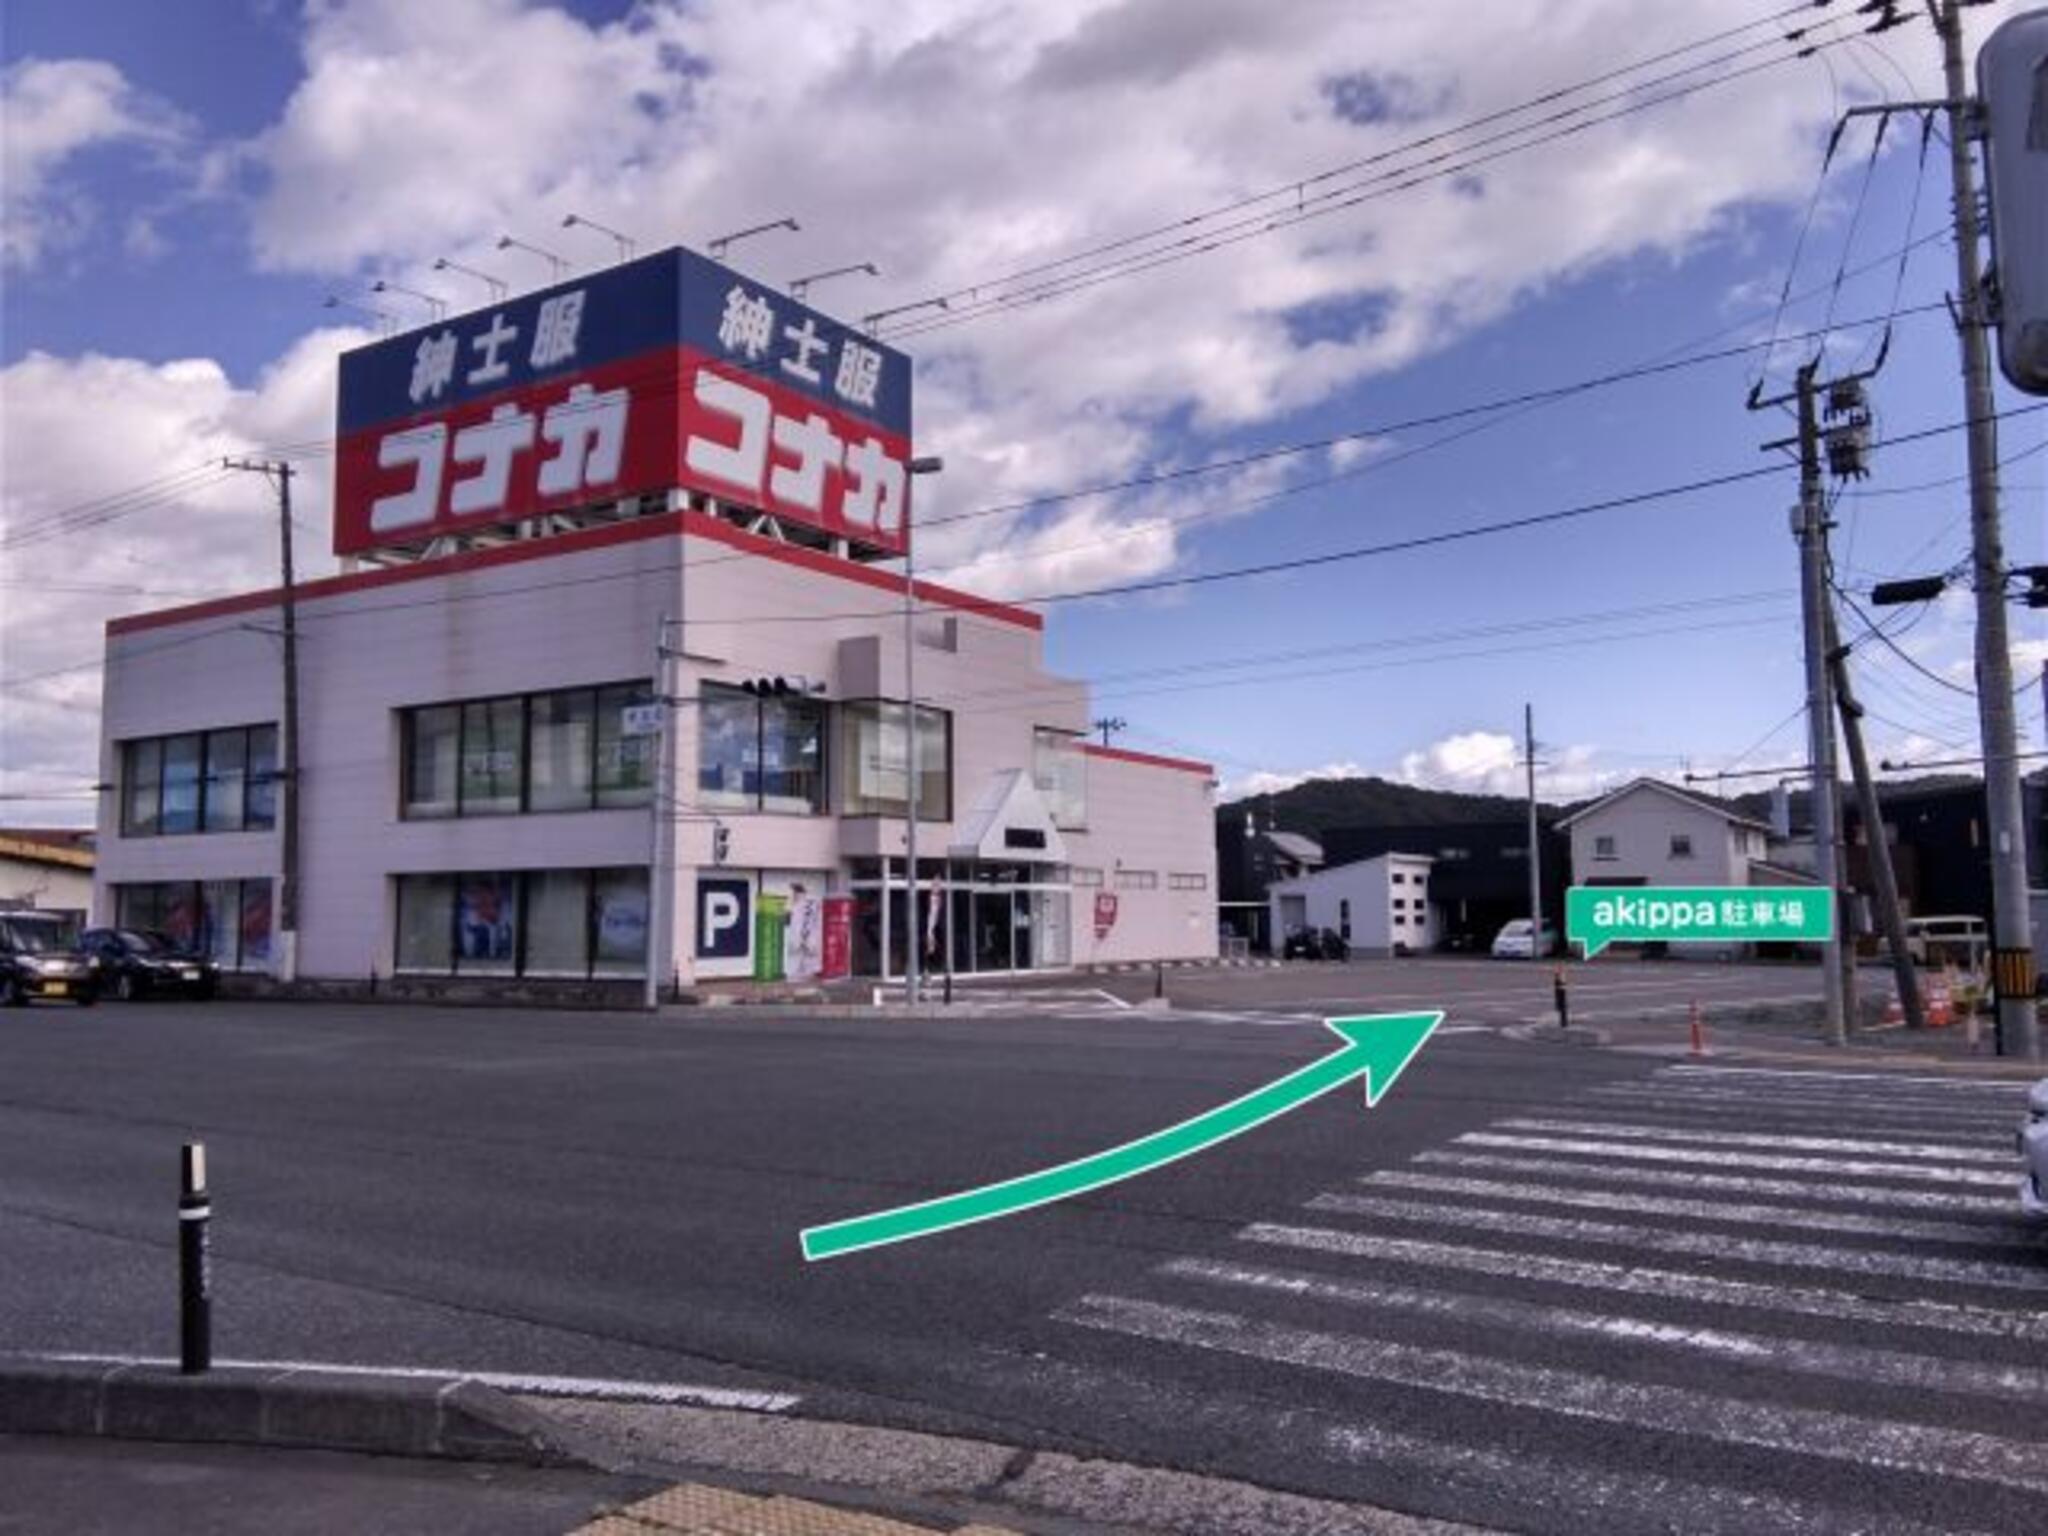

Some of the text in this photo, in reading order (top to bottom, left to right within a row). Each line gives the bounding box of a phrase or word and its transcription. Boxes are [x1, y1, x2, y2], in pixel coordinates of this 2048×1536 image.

[408, 289, 587, 402] 紳士服
[718, 284, 883, 408] 紳士服
[369, 383, 631, 532] コナカ
[685, 369, 905, 532] コナカ
[704, 891, 740, 948] P
